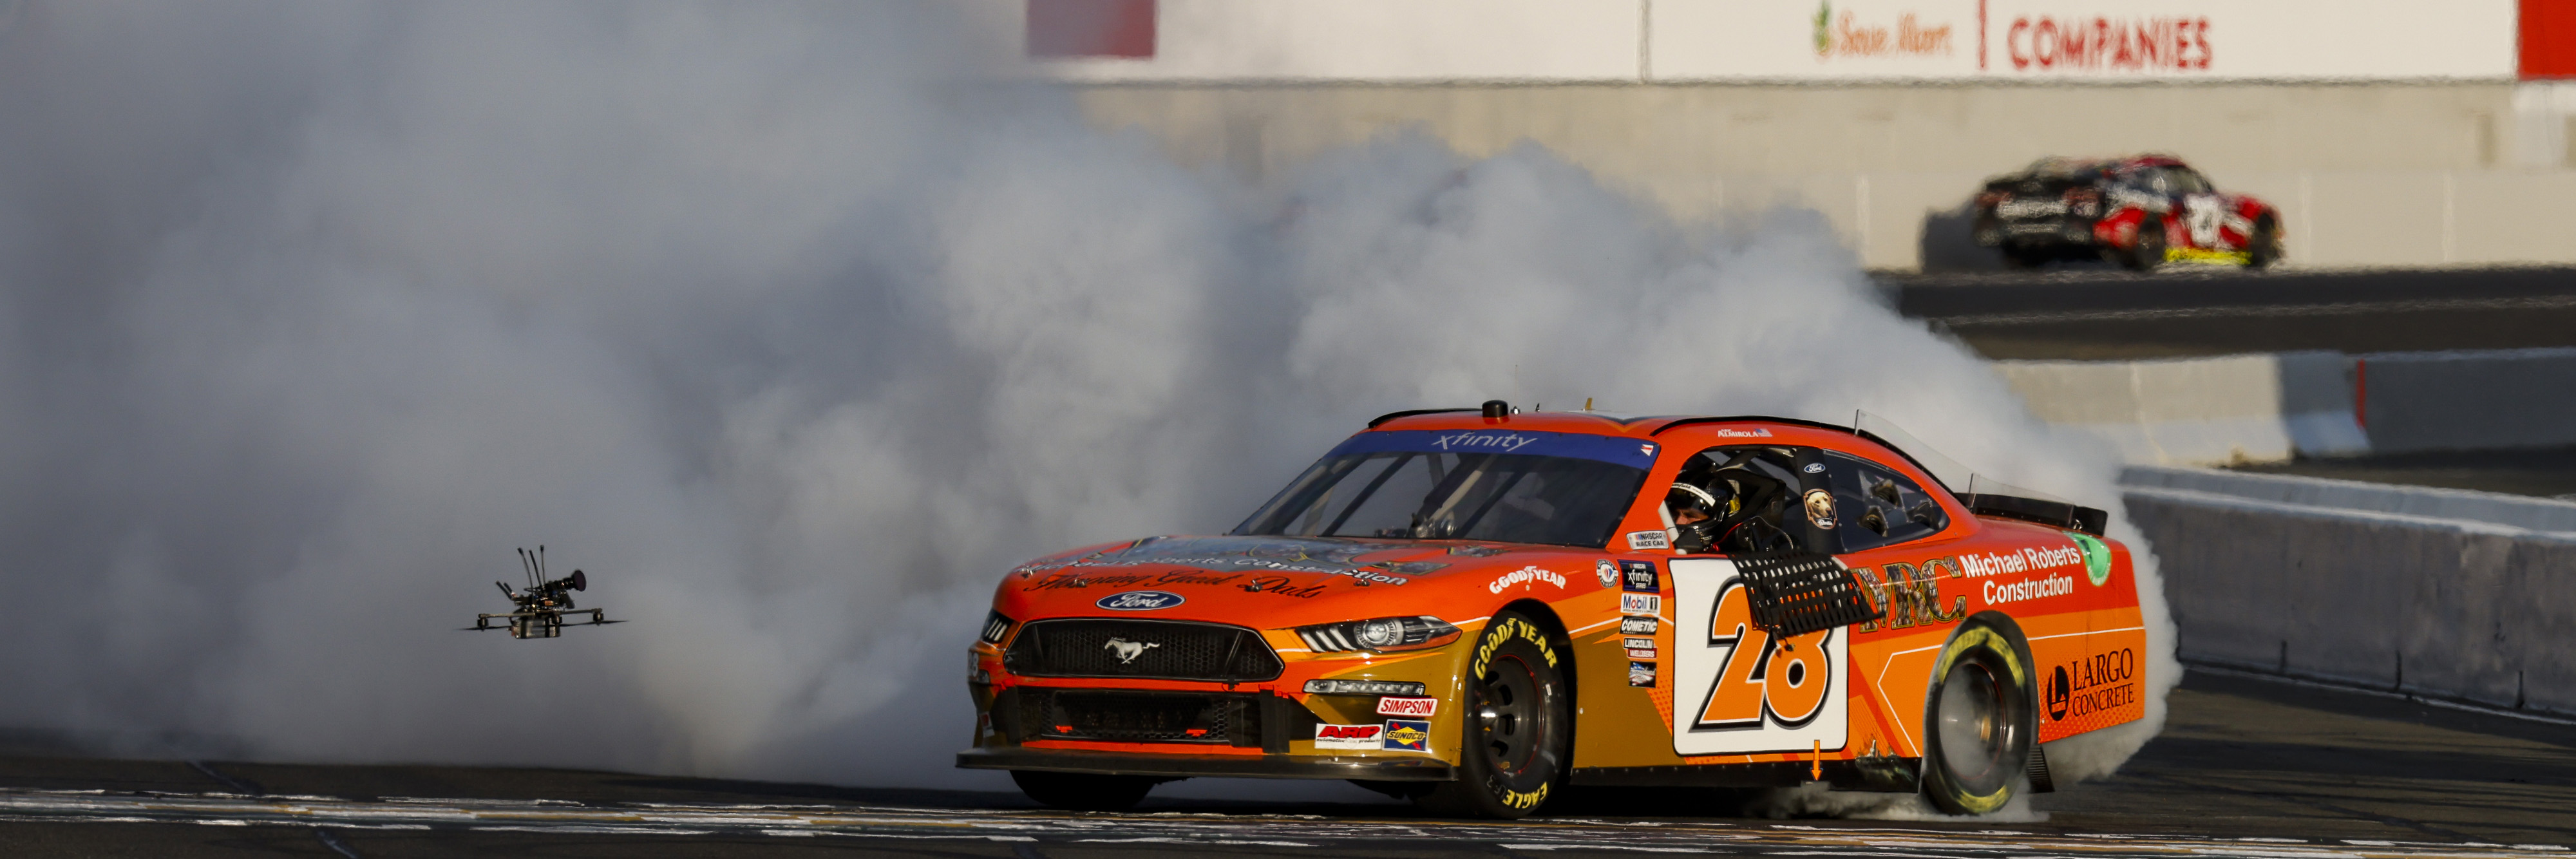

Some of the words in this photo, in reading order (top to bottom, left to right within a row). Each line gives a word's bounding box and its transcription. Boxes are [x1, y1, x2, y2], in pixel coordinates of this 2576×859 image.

[2007, 17, 2212, 70] COMPANIES
[1432, 432, 1537, 451] xfinity
[1808, 464, 1823, 472] Ford
[1959, 549, 2028, 578] Michael
[2023, 545, 2081, 570] Roberts
[1627, 569, 1653, 586] xfinity
[1984, 572, 2072, 606] Construction
[1110, 593, 1168, 607] Ford
[1623, 595, 1647, 609] Mobil
[1650, 597, 1658, 610] 1
[1622, 619, 1658, 632] COMETIC
[1625, 639, 1653, 648] LINCOLN
[1688, 575, 1833, 733] 28
[2072, 648, 2133, 691] LARGO
[1381, 699, 1434, 713] SIMPSON
[2072, 683, 2134, 717] CONCRETE
[1318, 726, 1380, 738] ARP
[1502, 781, 1548, 809] EAGLE
